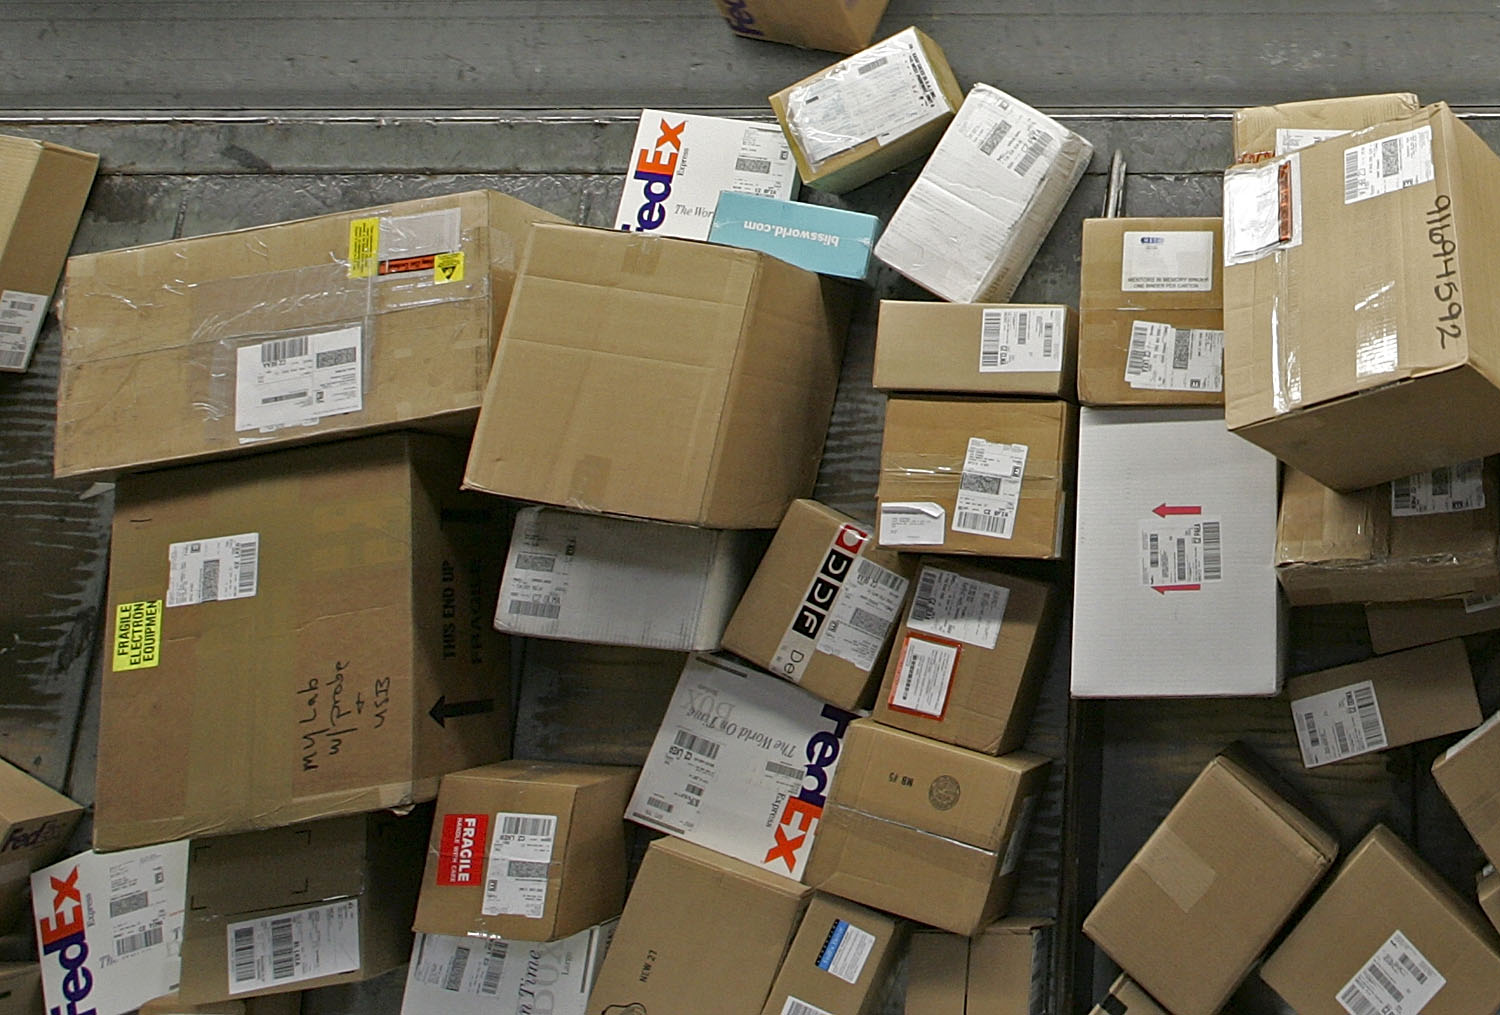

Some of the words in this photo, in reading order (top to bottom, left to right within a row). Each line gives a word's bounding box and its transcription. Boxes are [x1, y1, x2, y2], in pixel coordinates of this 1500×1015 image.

[677, 147, 689, 176] Express
[694, 205, 715, 217] Wor
[744, 220, 839, 247] blissworld.com
[1426, 195, 1462, 349] 91694592
[118, 605, 133, 656] FRAGILE
[784, 648, 805, 680] De
[687, 707, 720, 730] Time
[722, 721, 738, 735] On
[737, 729, 773, 750] World
[775, 739, 800, 759] The
[764, 703, 858, 873] FedEx
[768, 791, 785, 828] Express
[457, 818, 477, 882] FRAGILE
[518, 949, 544, 998] Time
[639, 961, 651, 983] NEW
